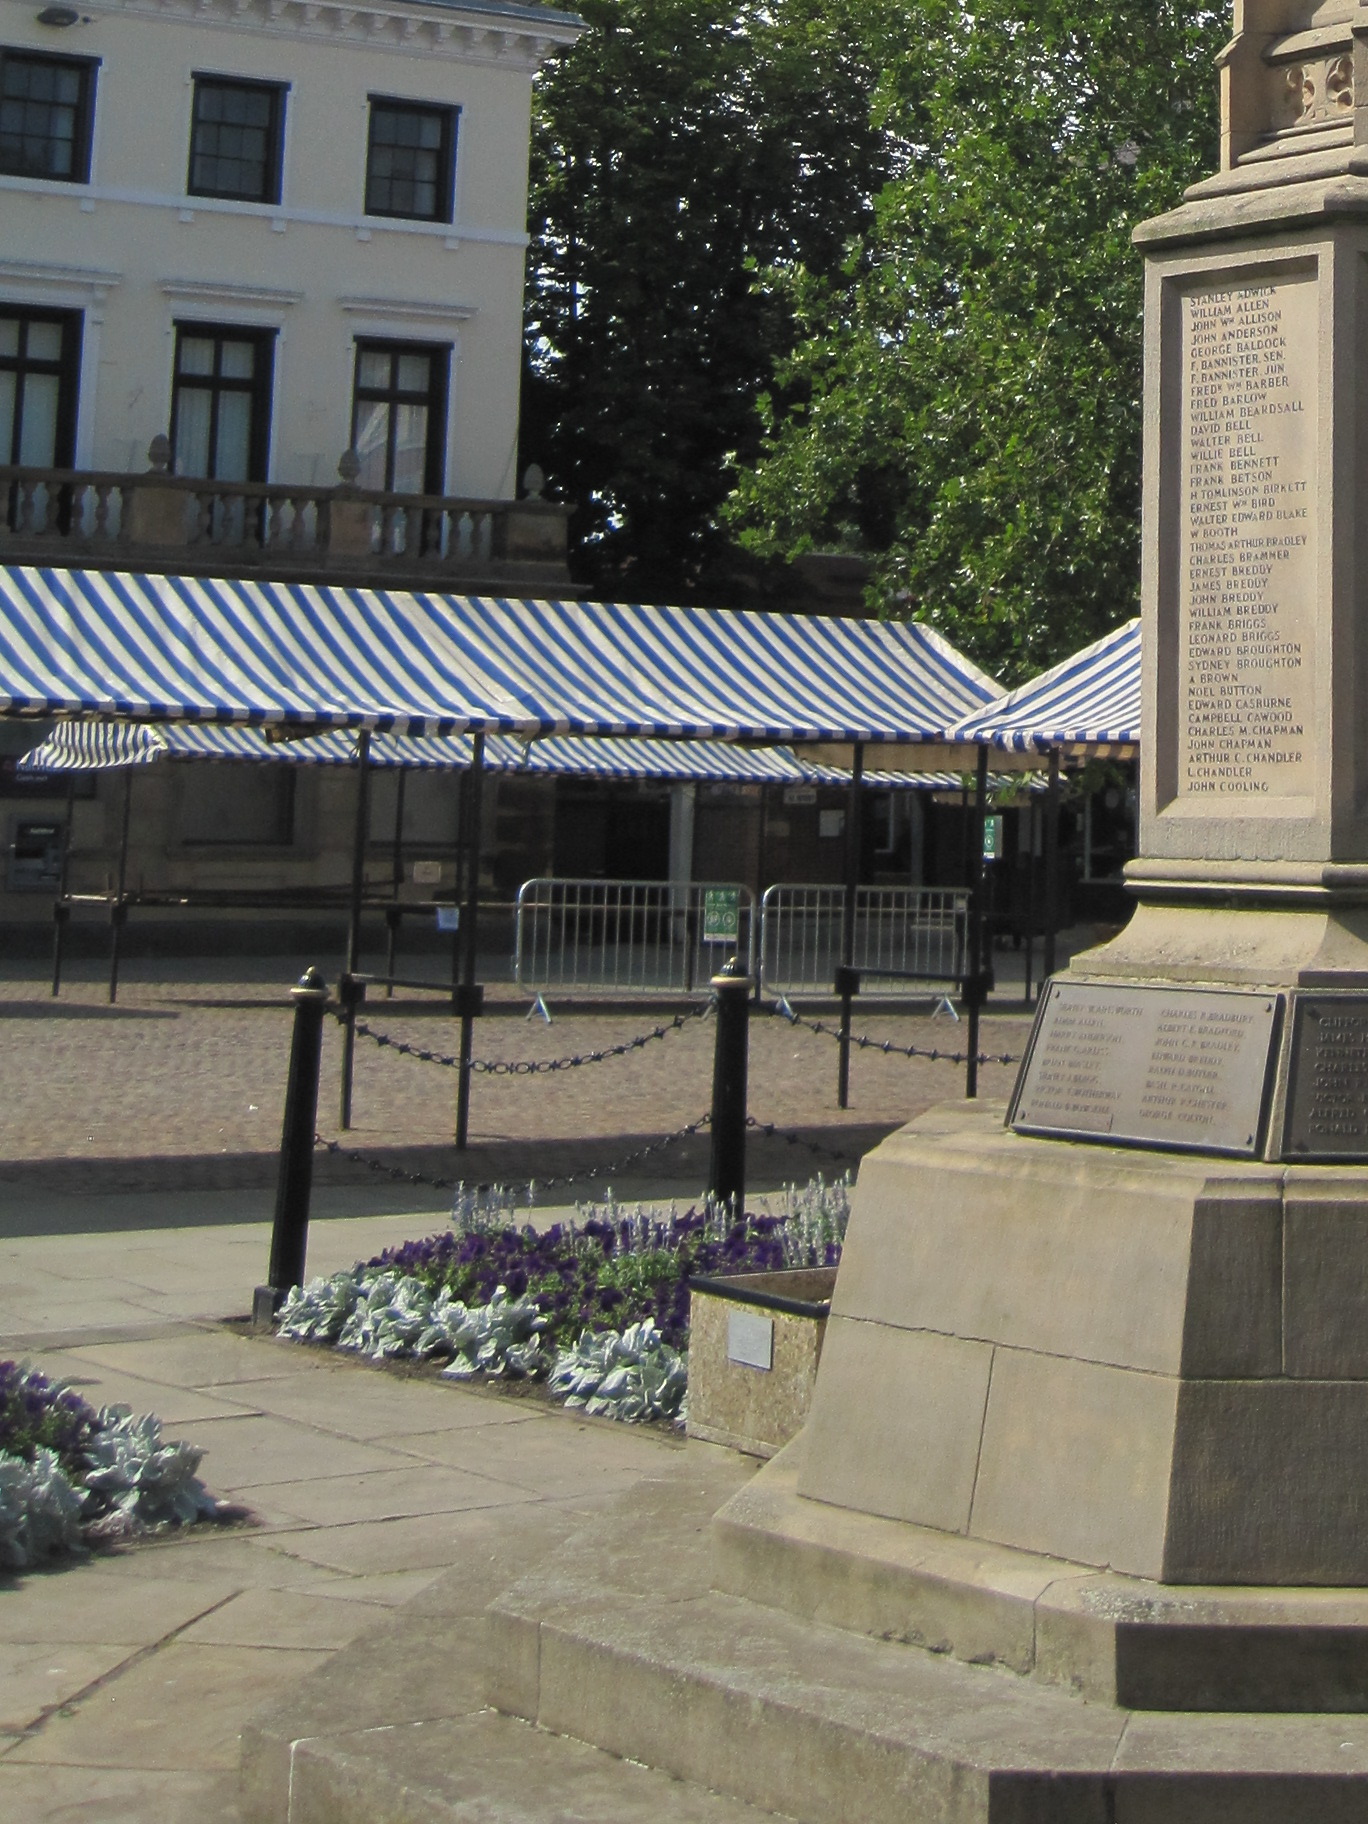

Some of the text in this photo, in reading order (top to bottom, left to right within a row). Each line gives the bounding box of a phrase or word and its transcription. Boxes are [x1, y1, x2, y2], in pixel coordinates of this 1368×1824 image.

[1191, 293, 1232, 306] STANLEY
[1191, 299, 1269, 318] WILLIAM ALLEN
[1191, 324, 1278, 345] JOHN ANDERSON
[1191, 337, 1286, 358] GEORGE BALDOCK
[1191, 393, 1267, 409] FRED BARLOW
[1191, 400, 1304, 422] WILLIAM BEARDSALL
[1191, 420, 1252, 435] DAVID BELL
[1191, 432, 1263, 446] WALTER BELL
[1191, 446, 1256, 460] WILLIE BELL
[1191, 456, 1279, 474] FRANK BENNETT
[1190, 471, 1273, 487] FRANK BETSON
[1191, 508, 1308, 526] WALTER EDWARD BLAKE
[1190, 550, 1290, 565] CHARLES BRAMMER
[1190, 564, 1273, 579] ERNEST BREDDY
[1189, 603, 1278, 617] WILLIAM BREDDY
[1189, 631, 1280, 644] LEONARD BRIGGS
[1189, 644, 1302, 658] EDWARD BROUGHTON
[1188, 657, 1302, 670] SYDNEY BROUGHTON
[1188, 685, 1262, 696] NOEL BUTTON
[1188, 712, 1292, 723] CAMPBELL CAWOOD
[1188, 739, 1271, 749] JOHN CHAPMAN
[1188, 782, 1269, 791] JOHN COOLING
